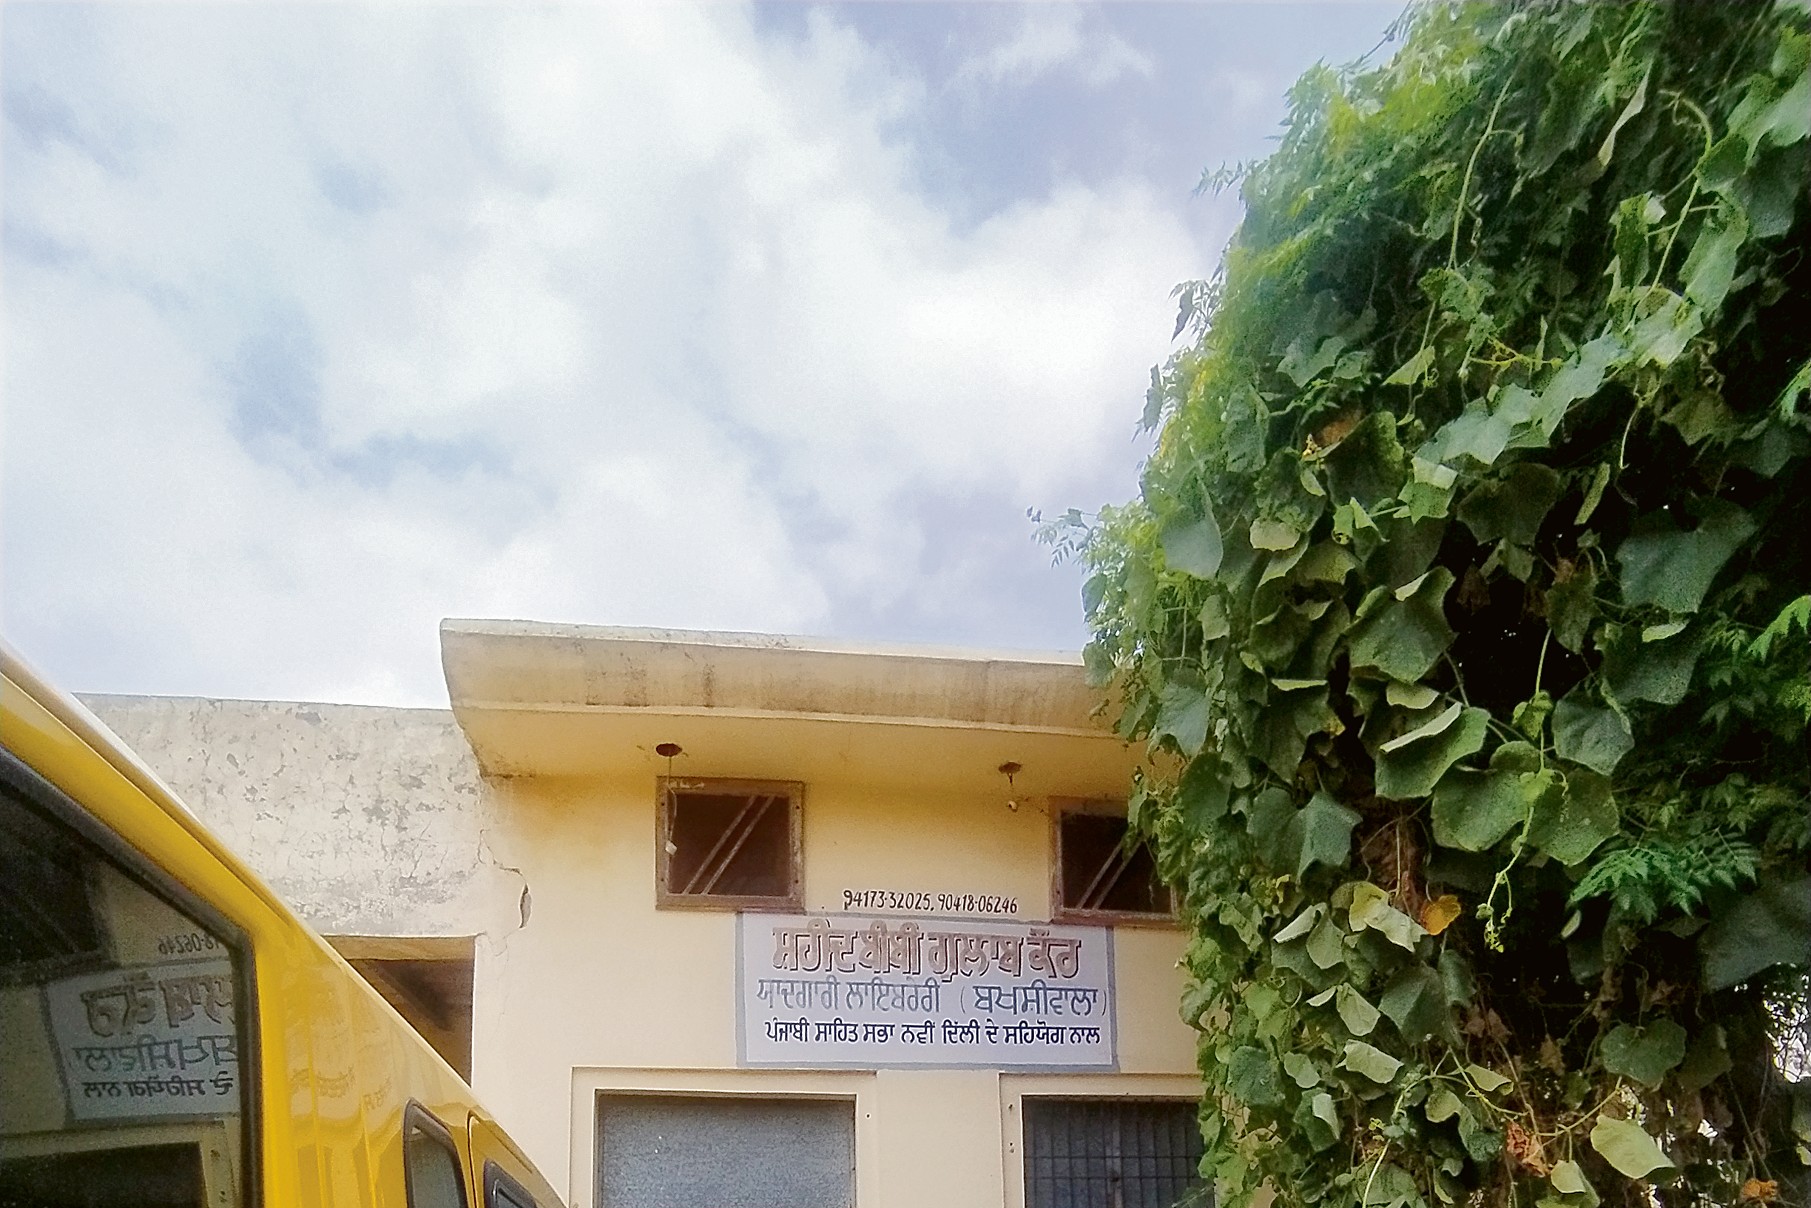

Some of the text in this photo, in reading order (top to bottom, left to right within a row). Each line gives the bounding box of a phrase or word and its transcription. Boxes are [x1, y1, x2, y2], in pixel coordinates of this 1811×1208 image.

[859, 919, 925, 975] ਬੀਬੀ
[927, 931, 1025, 983] ਗੁਲਾਬ
[756, 975, 841, 1010] ਯਾਦਗਾਰੀ
[765, 1017, 1101, 1045] ਪੰਜਾਬੀ ਸਾਹਿਤ ਸਭਾ ਨਵੀਂ ਦਿੱਲੀ ਦੇ ਸਹਿਯੋਗ ਨਾਲ
